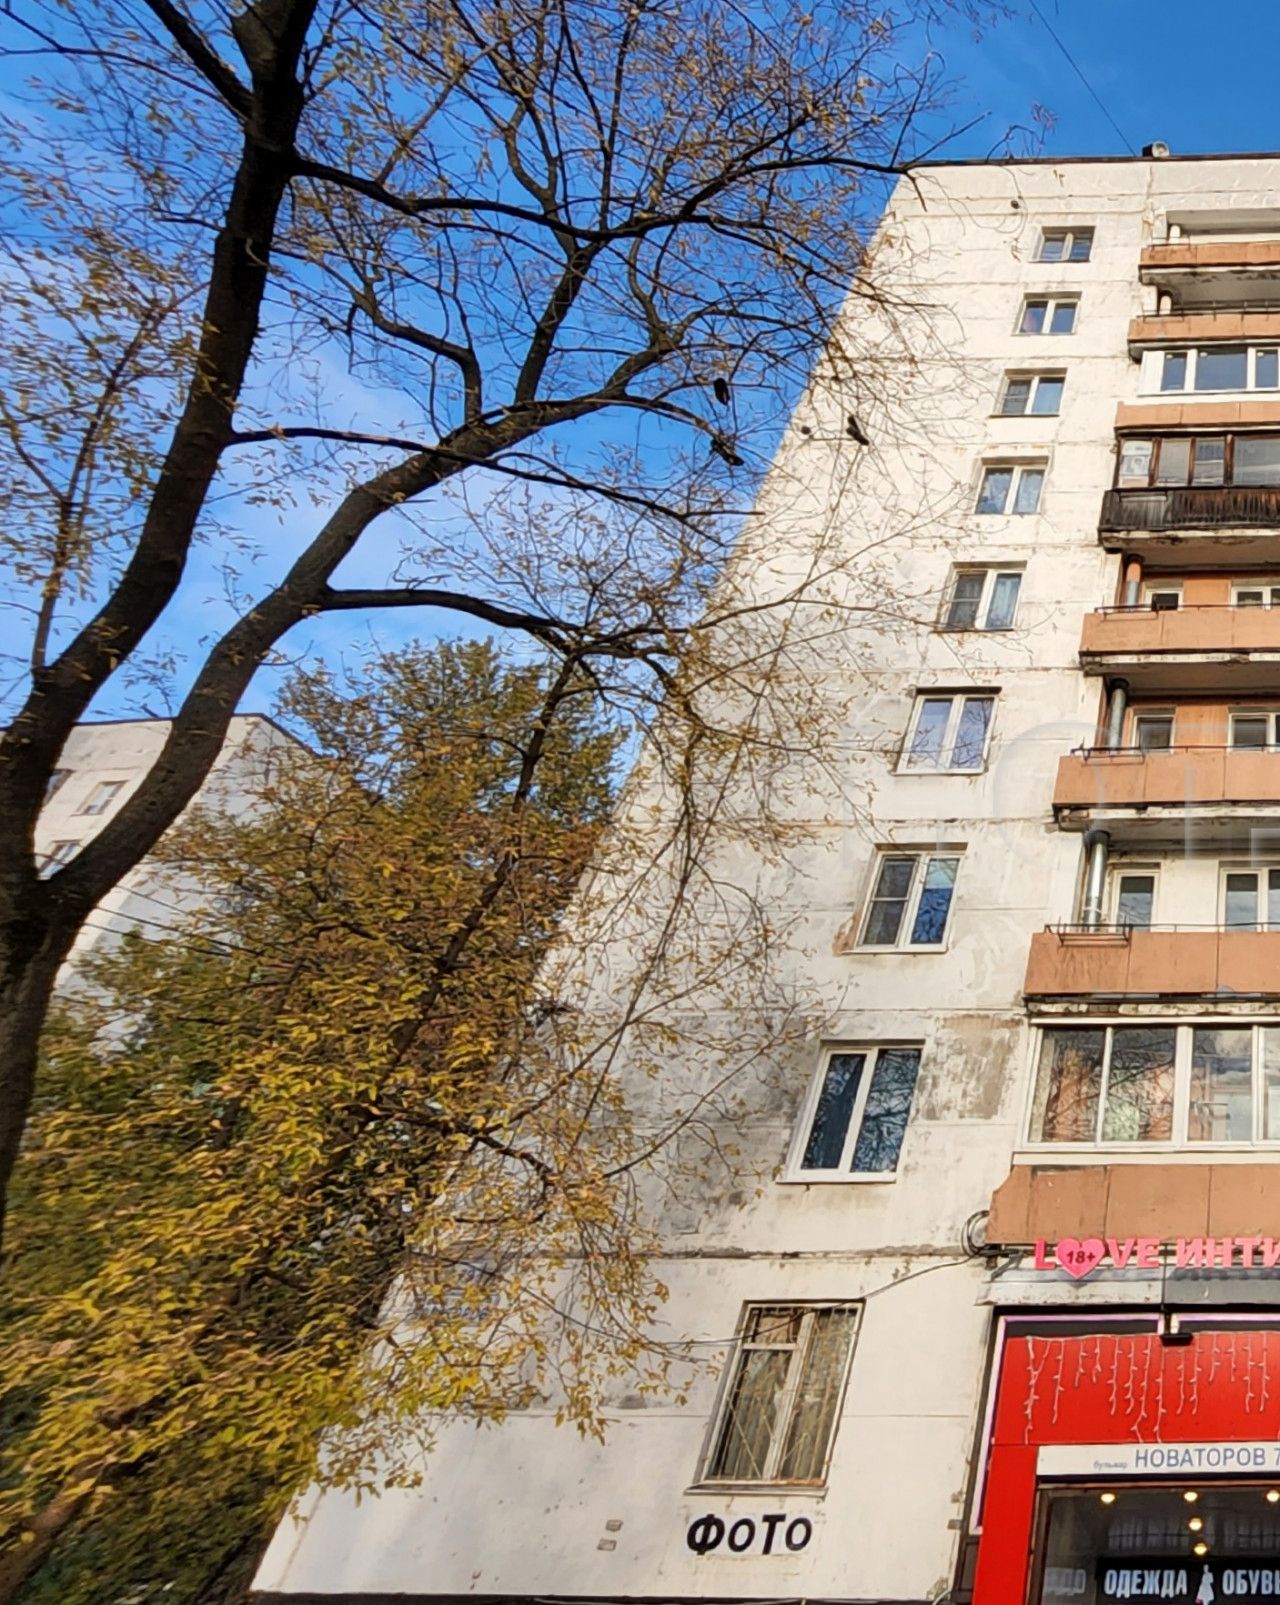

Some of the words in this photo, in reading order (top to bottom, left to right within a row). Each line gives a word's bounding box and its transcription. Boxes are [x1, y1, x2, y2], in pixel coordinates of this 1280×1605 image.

[1064, 1249, 1097, 1265] 18+
[1135, 1448, 1266, 1468] НОВАТОРОВ
[686, 1513, 813, 1556] ФОТО
[1104, 1569, 1188, 1599] ОДЕЖДА
